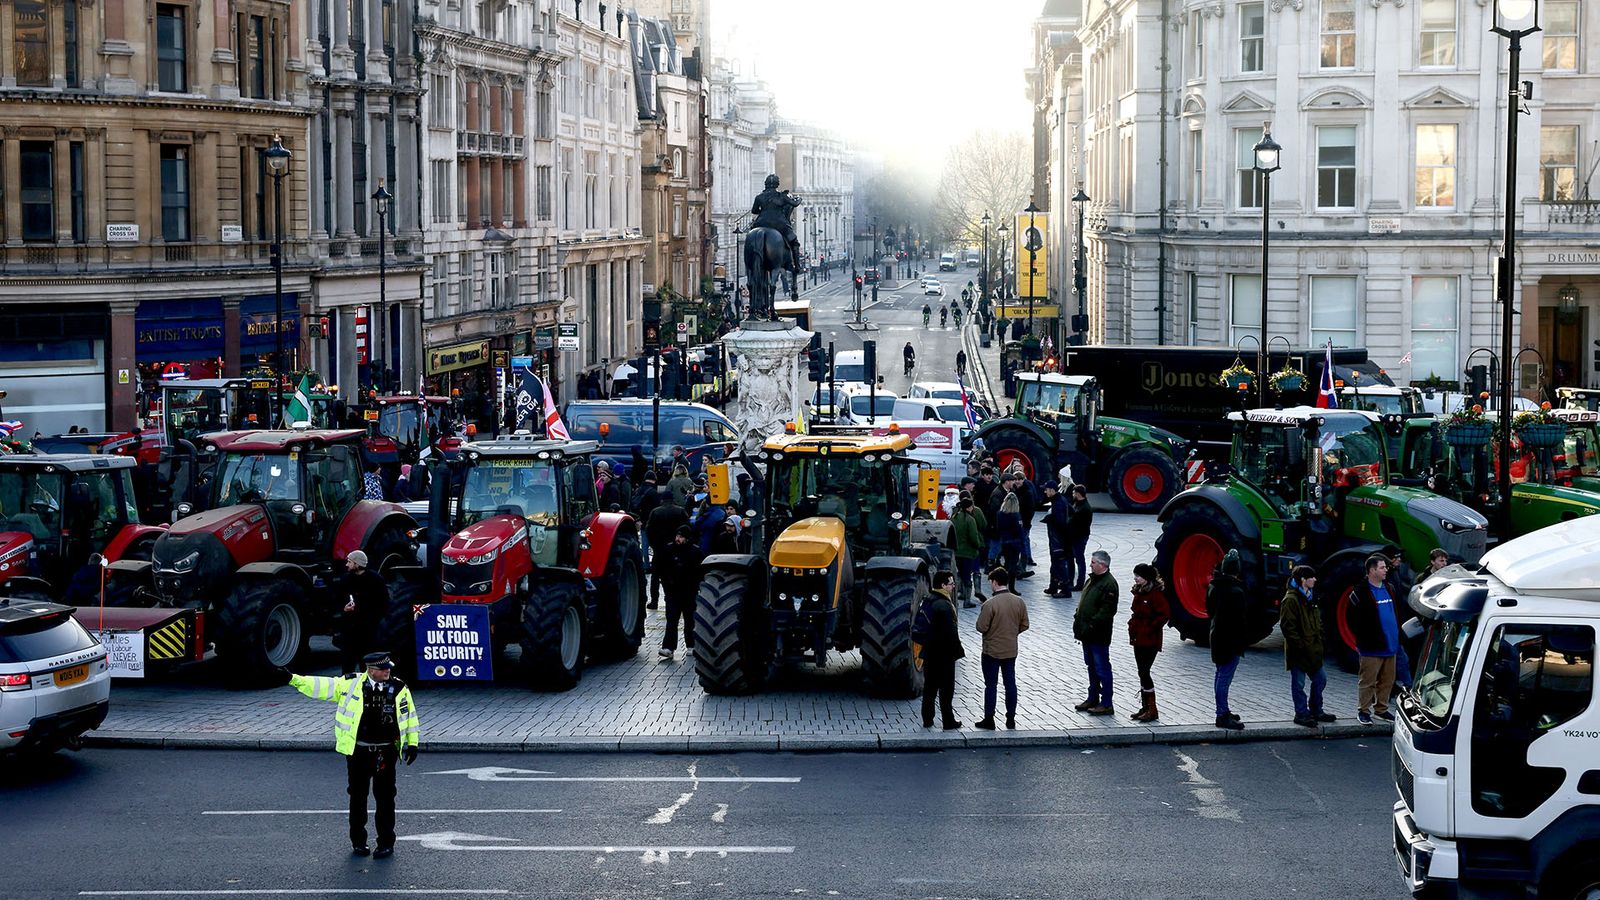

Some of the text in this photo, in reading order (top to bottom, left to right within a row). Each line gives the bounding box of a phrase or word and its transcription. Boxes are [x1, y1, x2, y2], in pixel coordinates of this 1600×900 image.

[1548, 254, 1600, 262] DRUMM
[139, 326, 222, 342] BRITISH TREATS
[247, 321, 271, 336] BRITISH
[1145, 366, 1220, 388] Jones
[1250, 414, 1278, 422] HYSLOP
[436, 614, 468, 628] SAVE
[427, 630, 479, 644] UK FOOD
[48, 652, 98, 667] RANGE ROVER
[112, 652, 137, 662] NEVER
[424, 646, 484, 660] SECURITY
